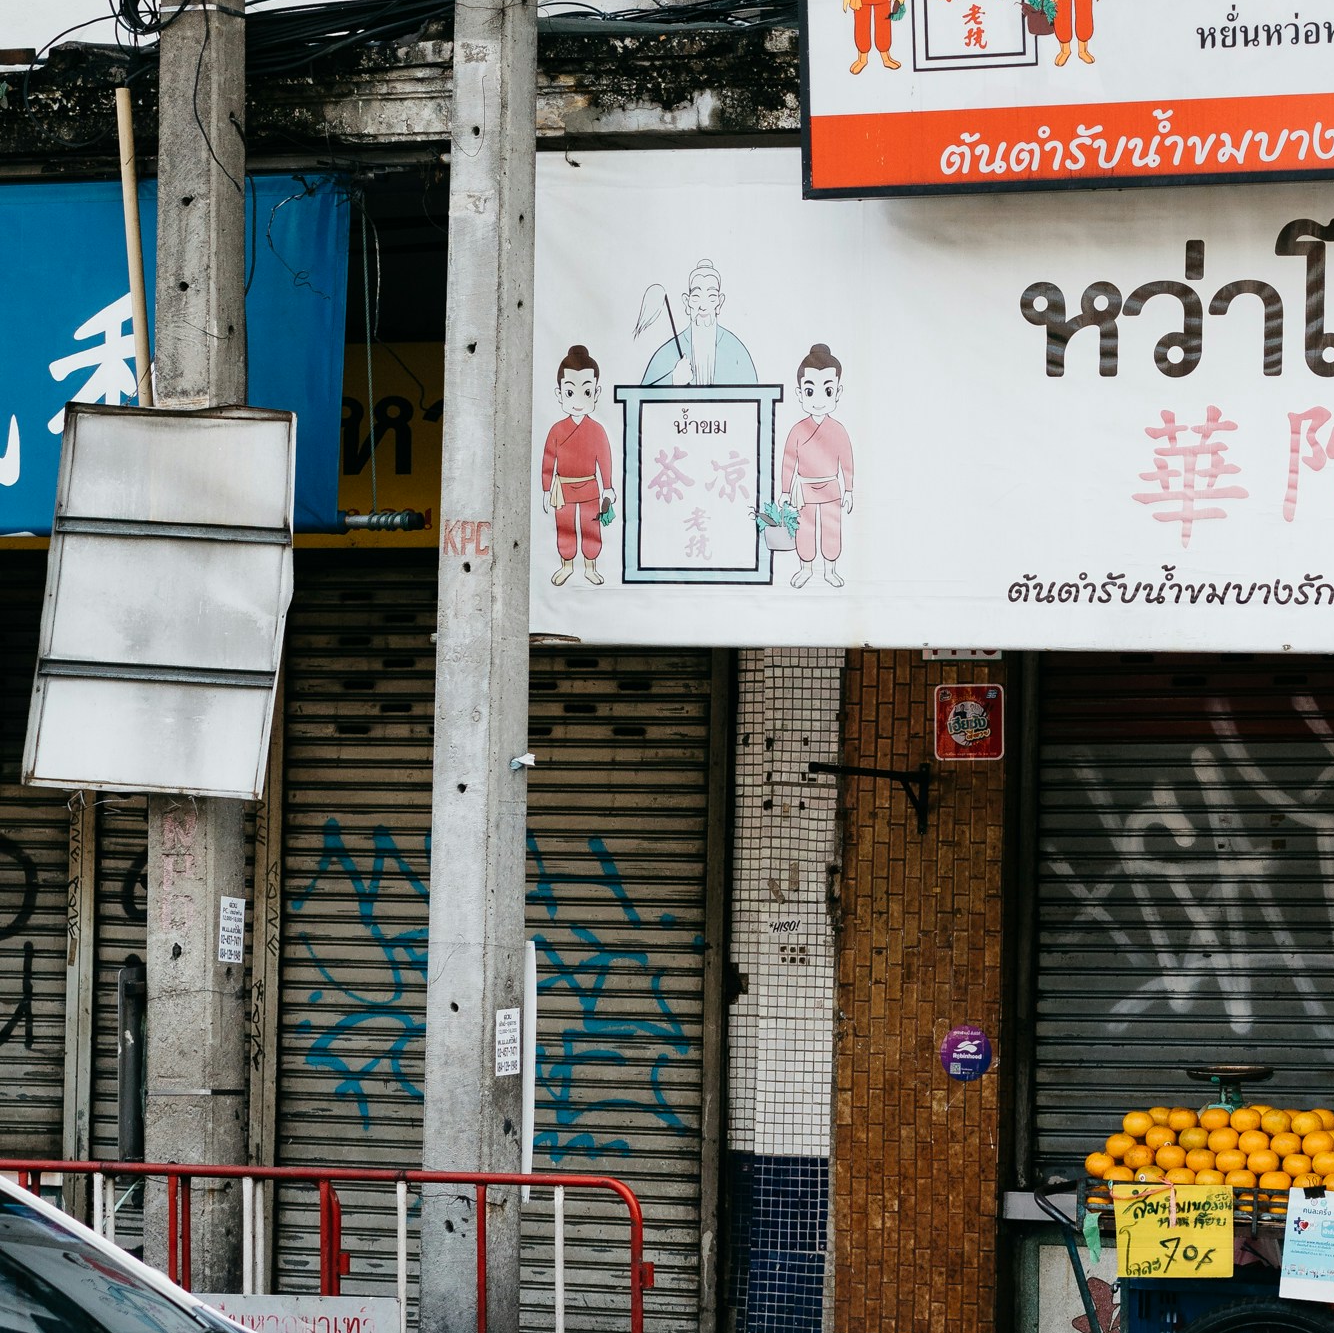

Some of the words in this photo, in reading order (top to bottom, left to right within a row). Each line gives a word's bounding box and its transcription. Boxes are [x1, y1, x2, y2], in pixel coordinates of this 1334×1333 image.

[674, 408, 727, 435] น้ำขม
[443, 521, 490, 556] KPC
[1007, 564, 1334, 606] ต้นตำรับน้ำขมบางรัก
[1302, 1207, 1332, 1216] คนละครึ่ง
